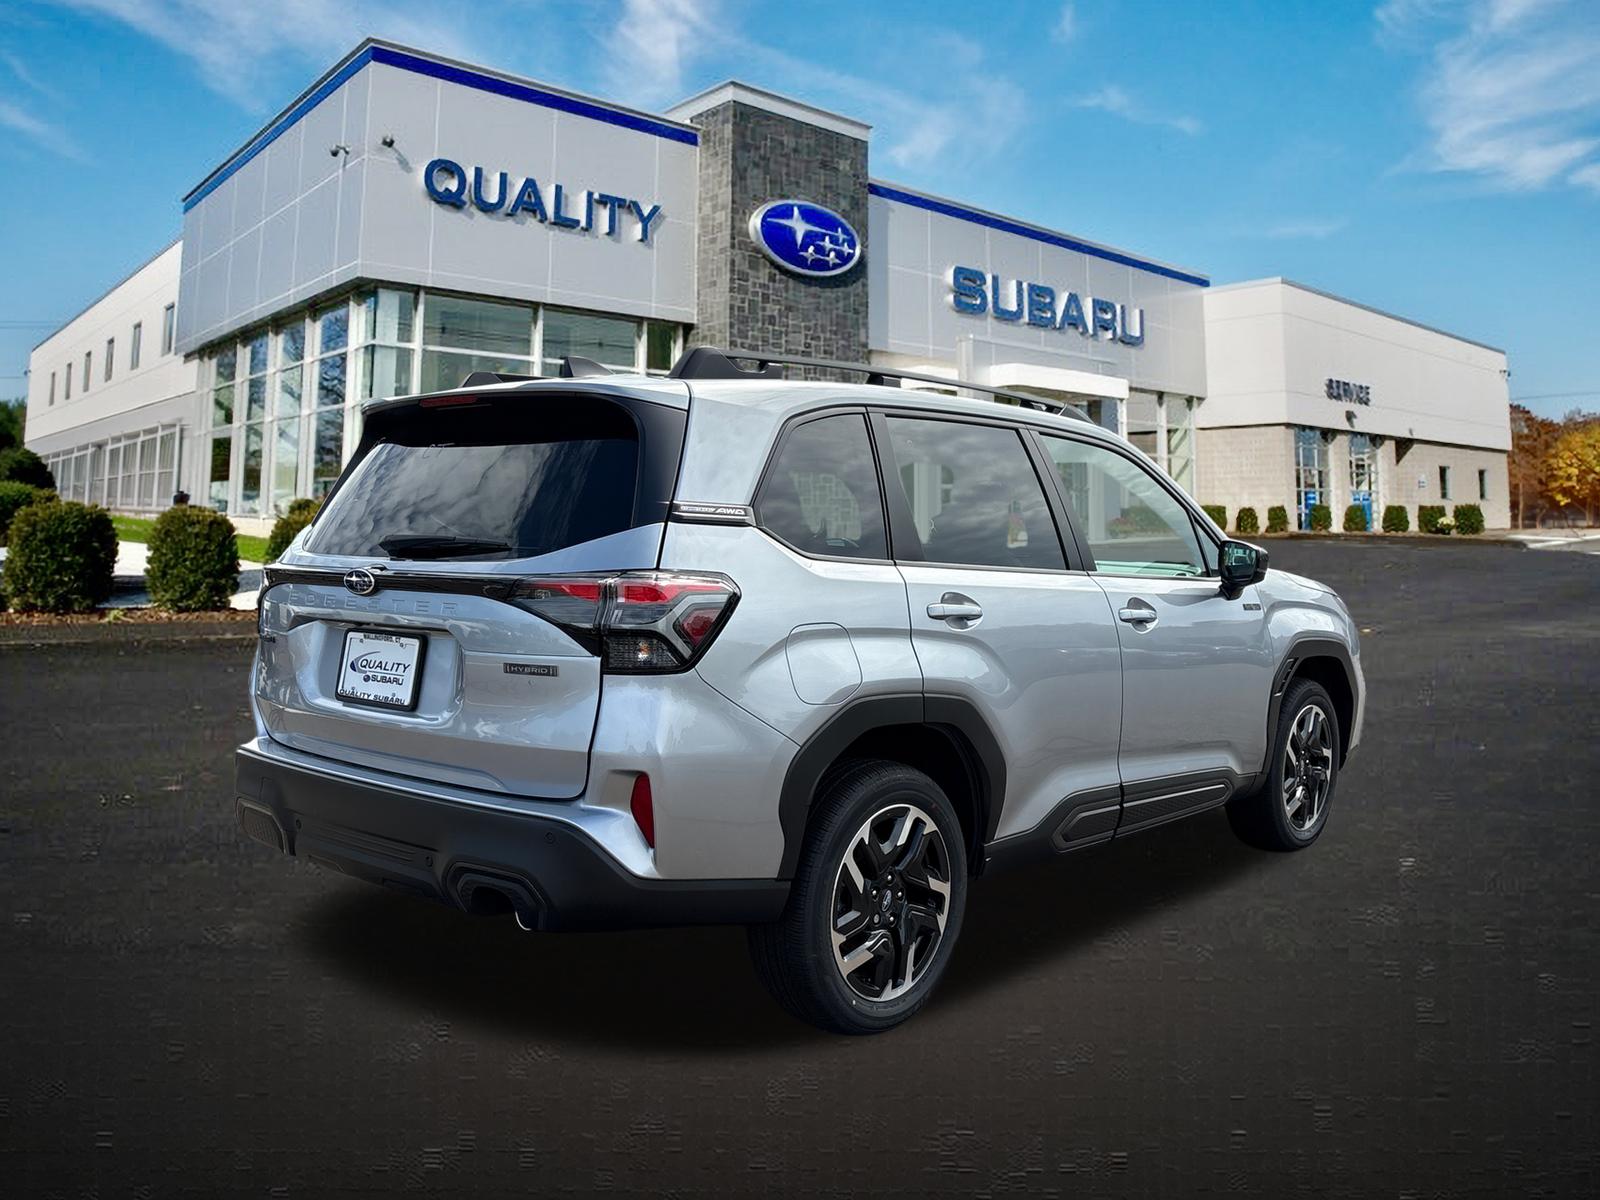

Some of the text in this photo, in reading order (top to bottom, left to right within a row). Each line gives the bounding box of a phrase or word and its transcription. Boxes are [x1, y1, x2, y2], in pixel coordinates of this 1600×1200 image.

[424, 158, 661, 242] QUALITY
[951, 265, 1145, 346] SUBARU
[1325, 378, 1371, 407] SERVICE
[715, 507, 745, 515] AWD
[289, 593, 458, 617] FORESTER
[360, 659, 410, 673] QUALITY
[511, 665, 548, 674] HYBRID
[371, 674, 404, 685] SUBARU
[340, 688, 405, 705] QUALITY SUBARU
